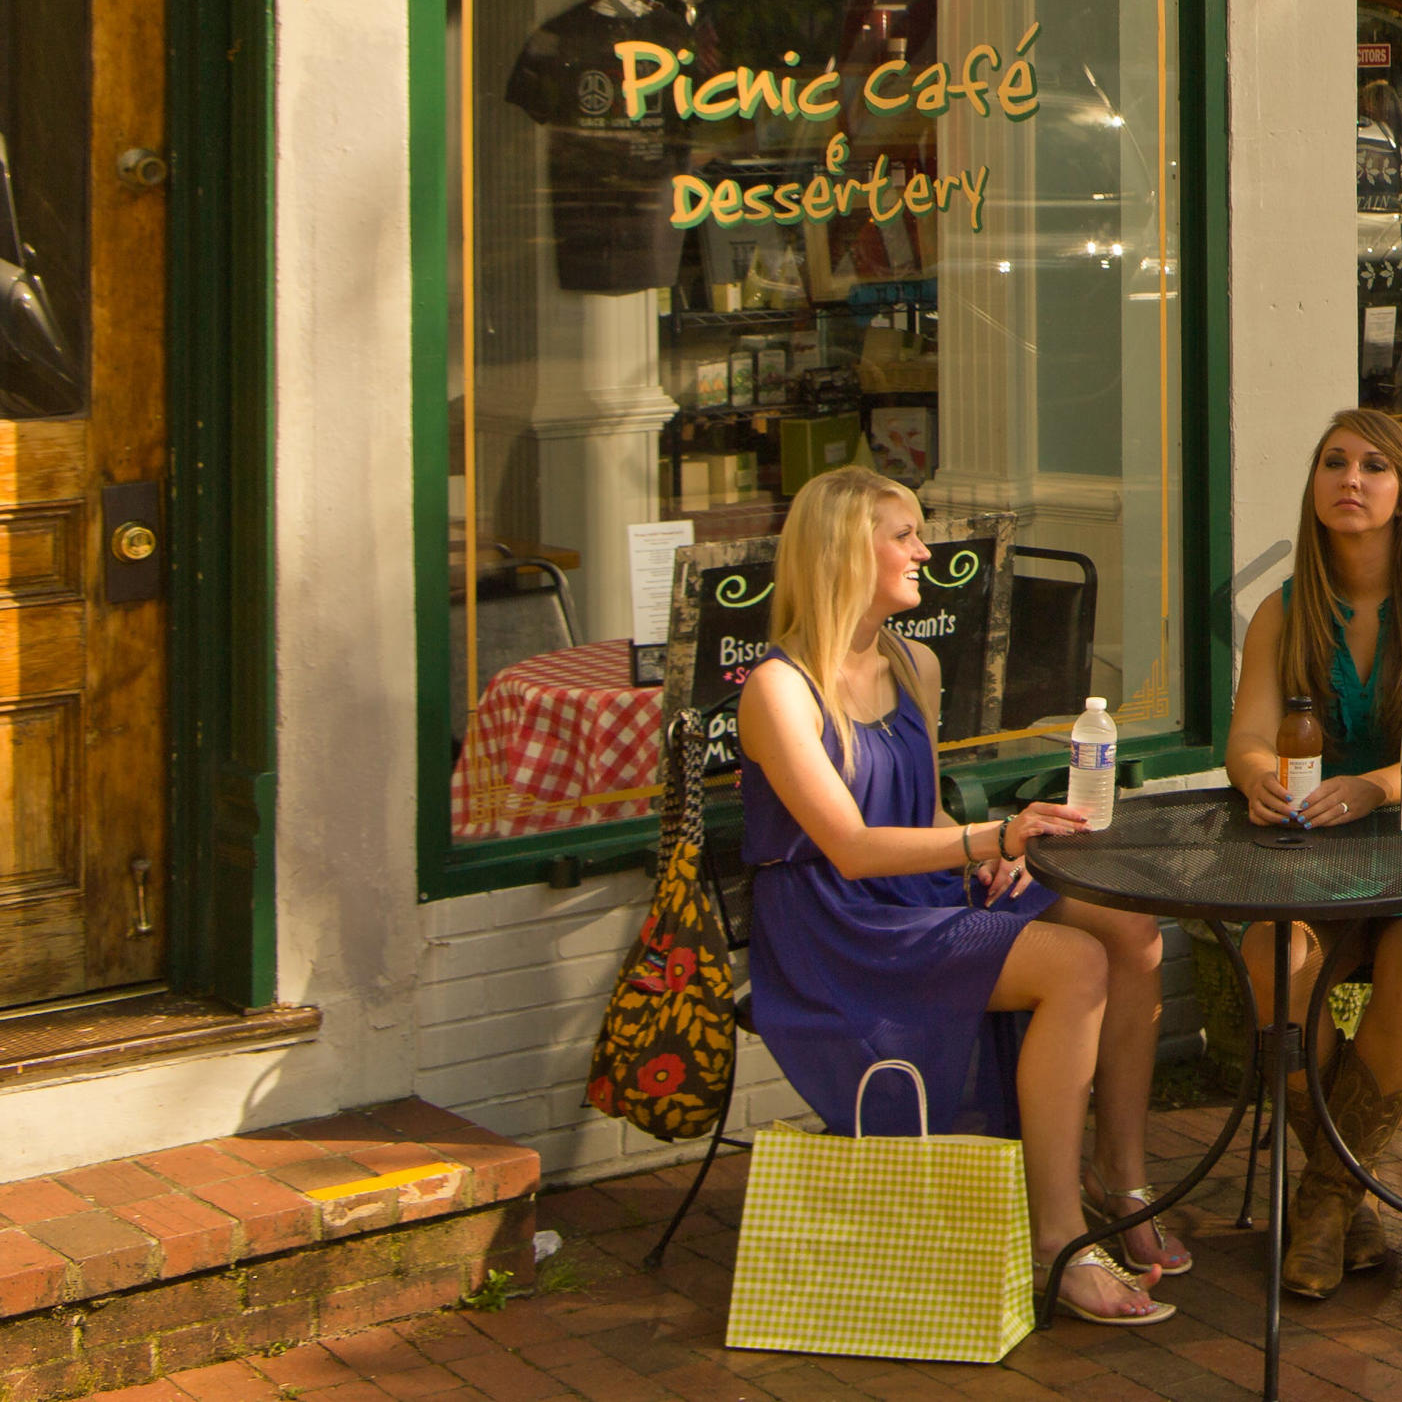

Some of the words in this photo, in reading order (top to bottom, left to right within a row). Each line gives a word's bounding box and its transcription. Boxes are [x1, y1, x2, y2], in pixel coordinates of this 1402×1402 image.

[613, 40, 841, 121] Picnic
[669, 153, 989, 232] Dessertery
[881, 609, 957, 639] issants
